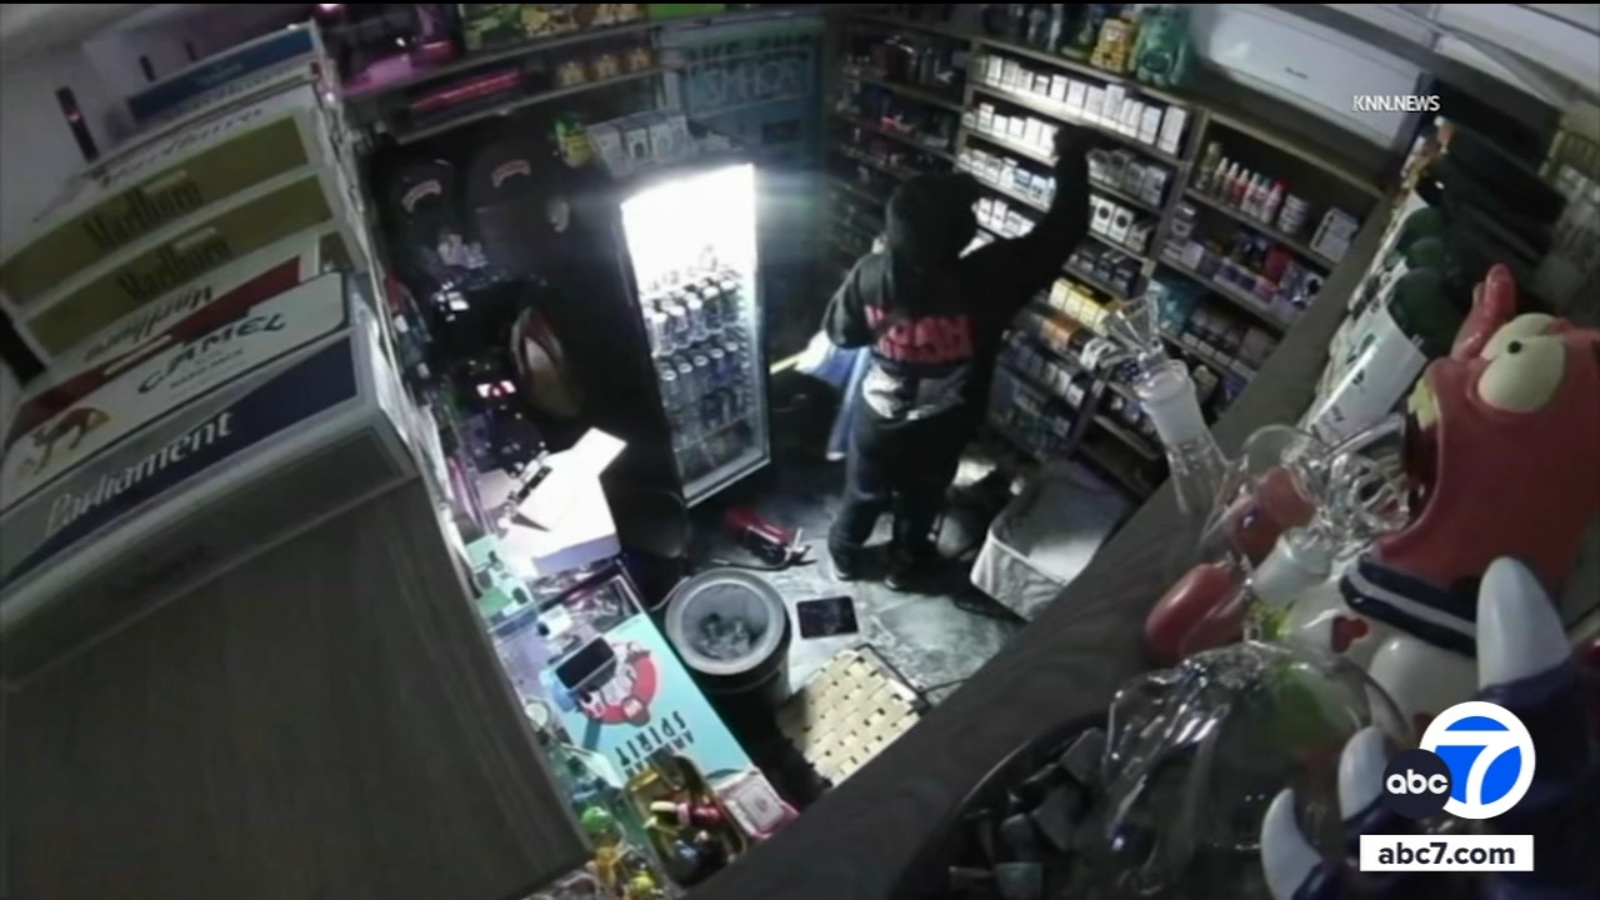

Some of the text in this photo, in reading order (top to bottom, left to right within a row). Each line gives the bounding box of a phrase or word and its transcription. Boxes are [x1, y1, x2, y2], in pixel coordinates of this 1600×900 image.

[137, 312, 286, 394] CAMEL
[45, 411, 233, 537] Parliament
[614, 710, 687, 768] SPIRIT
